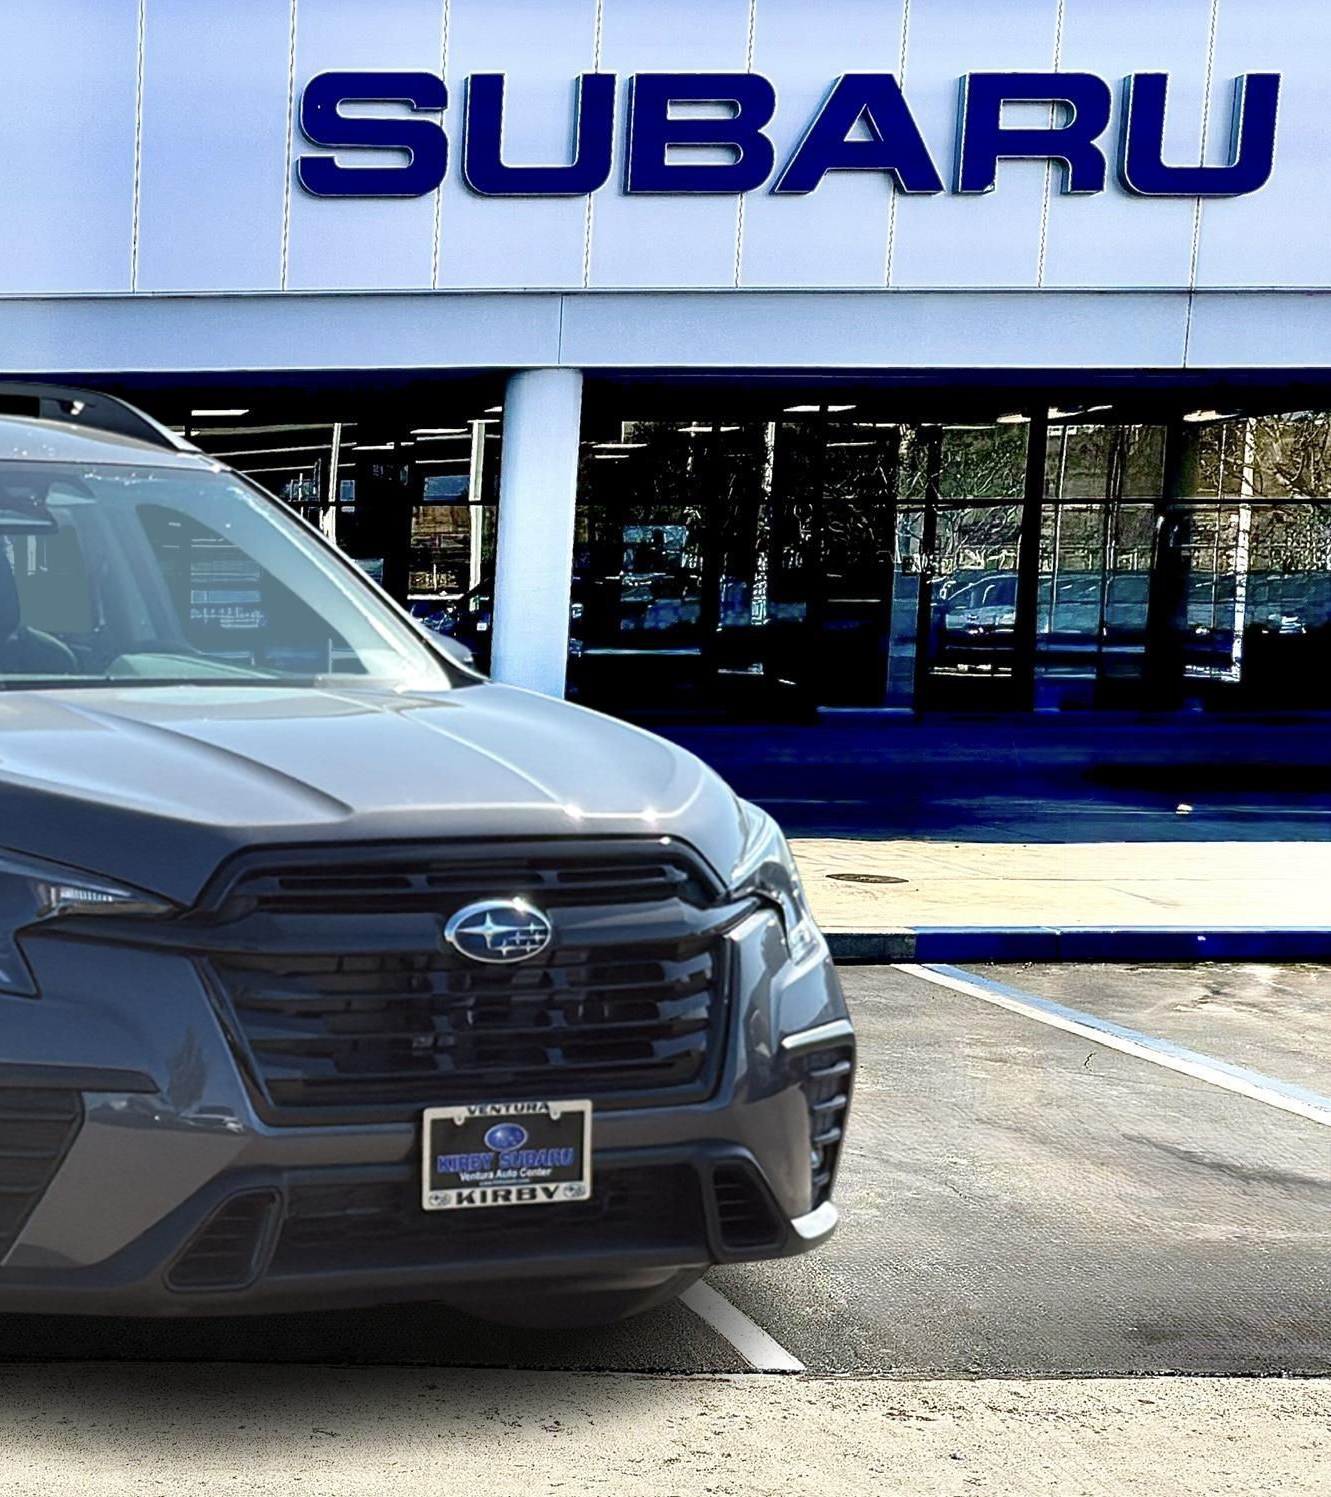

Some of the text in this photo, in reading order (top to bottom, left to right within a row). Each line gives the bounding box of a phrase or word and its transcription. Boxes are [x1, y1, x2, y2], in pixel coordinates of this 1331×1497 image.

[296, 71, 1282, 198] SUBARU
[467, 1102, 550, 1115] VENTURA
[437, 1147, 574, 1173] KIRBY SUBARU
[459, 1167, 552, 1182] Ventura Auto Center
[455, 1185, 560, 1206] KIRBY
